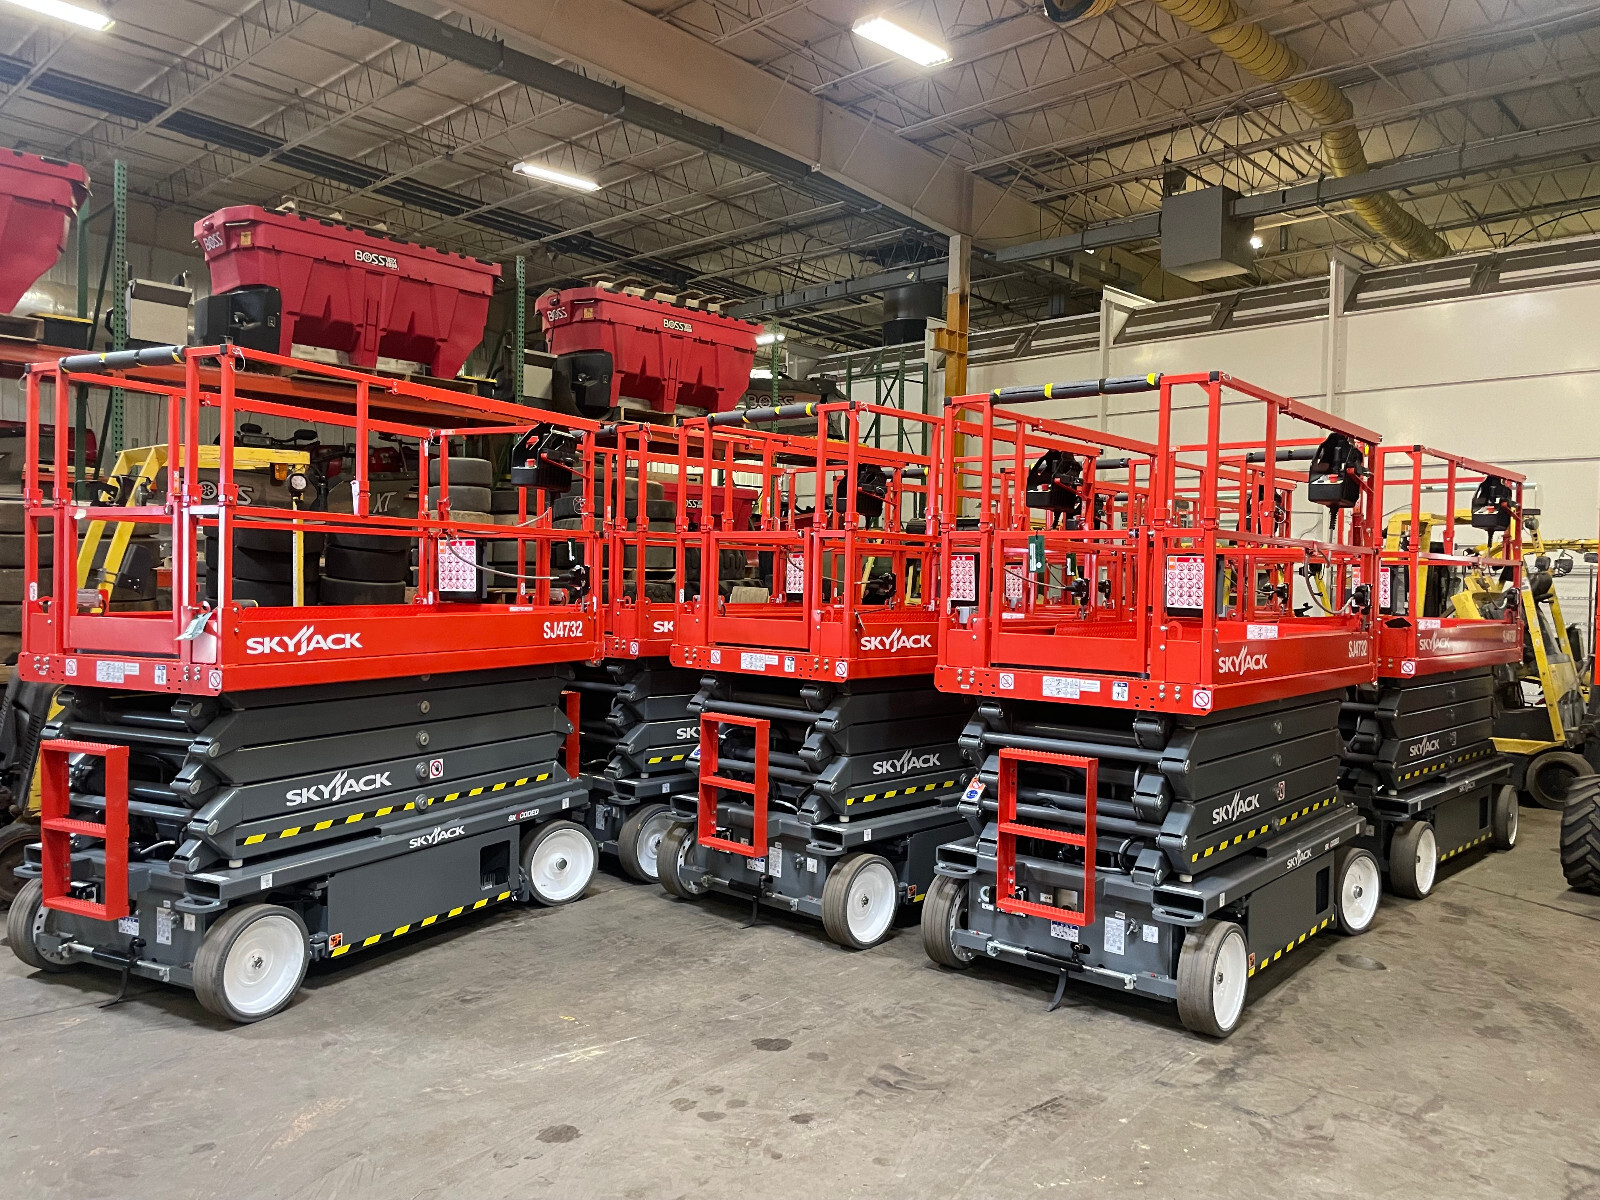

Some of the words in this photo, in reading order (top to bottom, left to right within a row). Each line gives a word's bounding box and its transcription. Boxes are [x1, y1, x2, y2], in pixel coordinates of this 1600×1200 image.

[203, 231, 223, 251] BOSS
[354, 249, 386, 266] BOSS
[547, 306, 568, 321] BOSS
[663, 319, 684, 331] BOSS
[373, 491, 397, 513] XT
[246, 624, 363, 656] SKYJACK
[543, 620, 583, 639] SJ4732
[860, 627, 932, 653] SKYJACK
[1419, 631, 1450, 652] SKYJACK
[1218, 645, 1268, 676] SKYJACK
[1409, 736, 1440, 757] SKYJACK
[872, 748, 941, 775] SKYJACK
[285, 770, 392, 807] SKYJACK
[1212, 791, 1260, 825] SKYJACK
[409, 825, 466, 849] SKYJACK
[1286, 847, 1312, 870] SKYJACK
